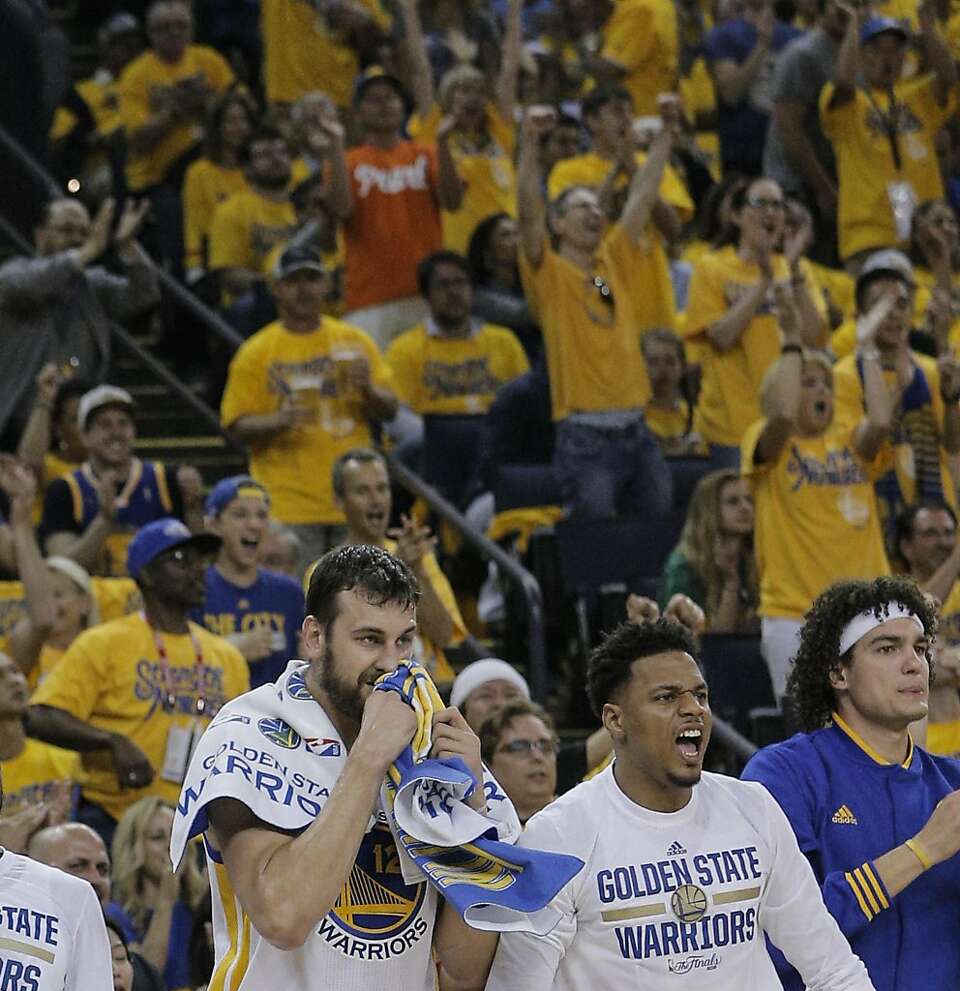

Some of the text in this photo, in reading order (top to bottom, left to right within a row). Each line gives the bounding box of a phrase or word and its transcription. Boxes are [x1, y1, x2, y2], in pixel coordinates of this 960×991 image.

[178, 755, 322, 818] WRRIO
[291, 773, 330, 798] STA
[596, 846, 762, 904] GOLDEN STATE
[317, 917, 428, 960] WARRIORS
[614, 907, 756, 960] WARRIORS
[686, 953, 721, 969] Finals
